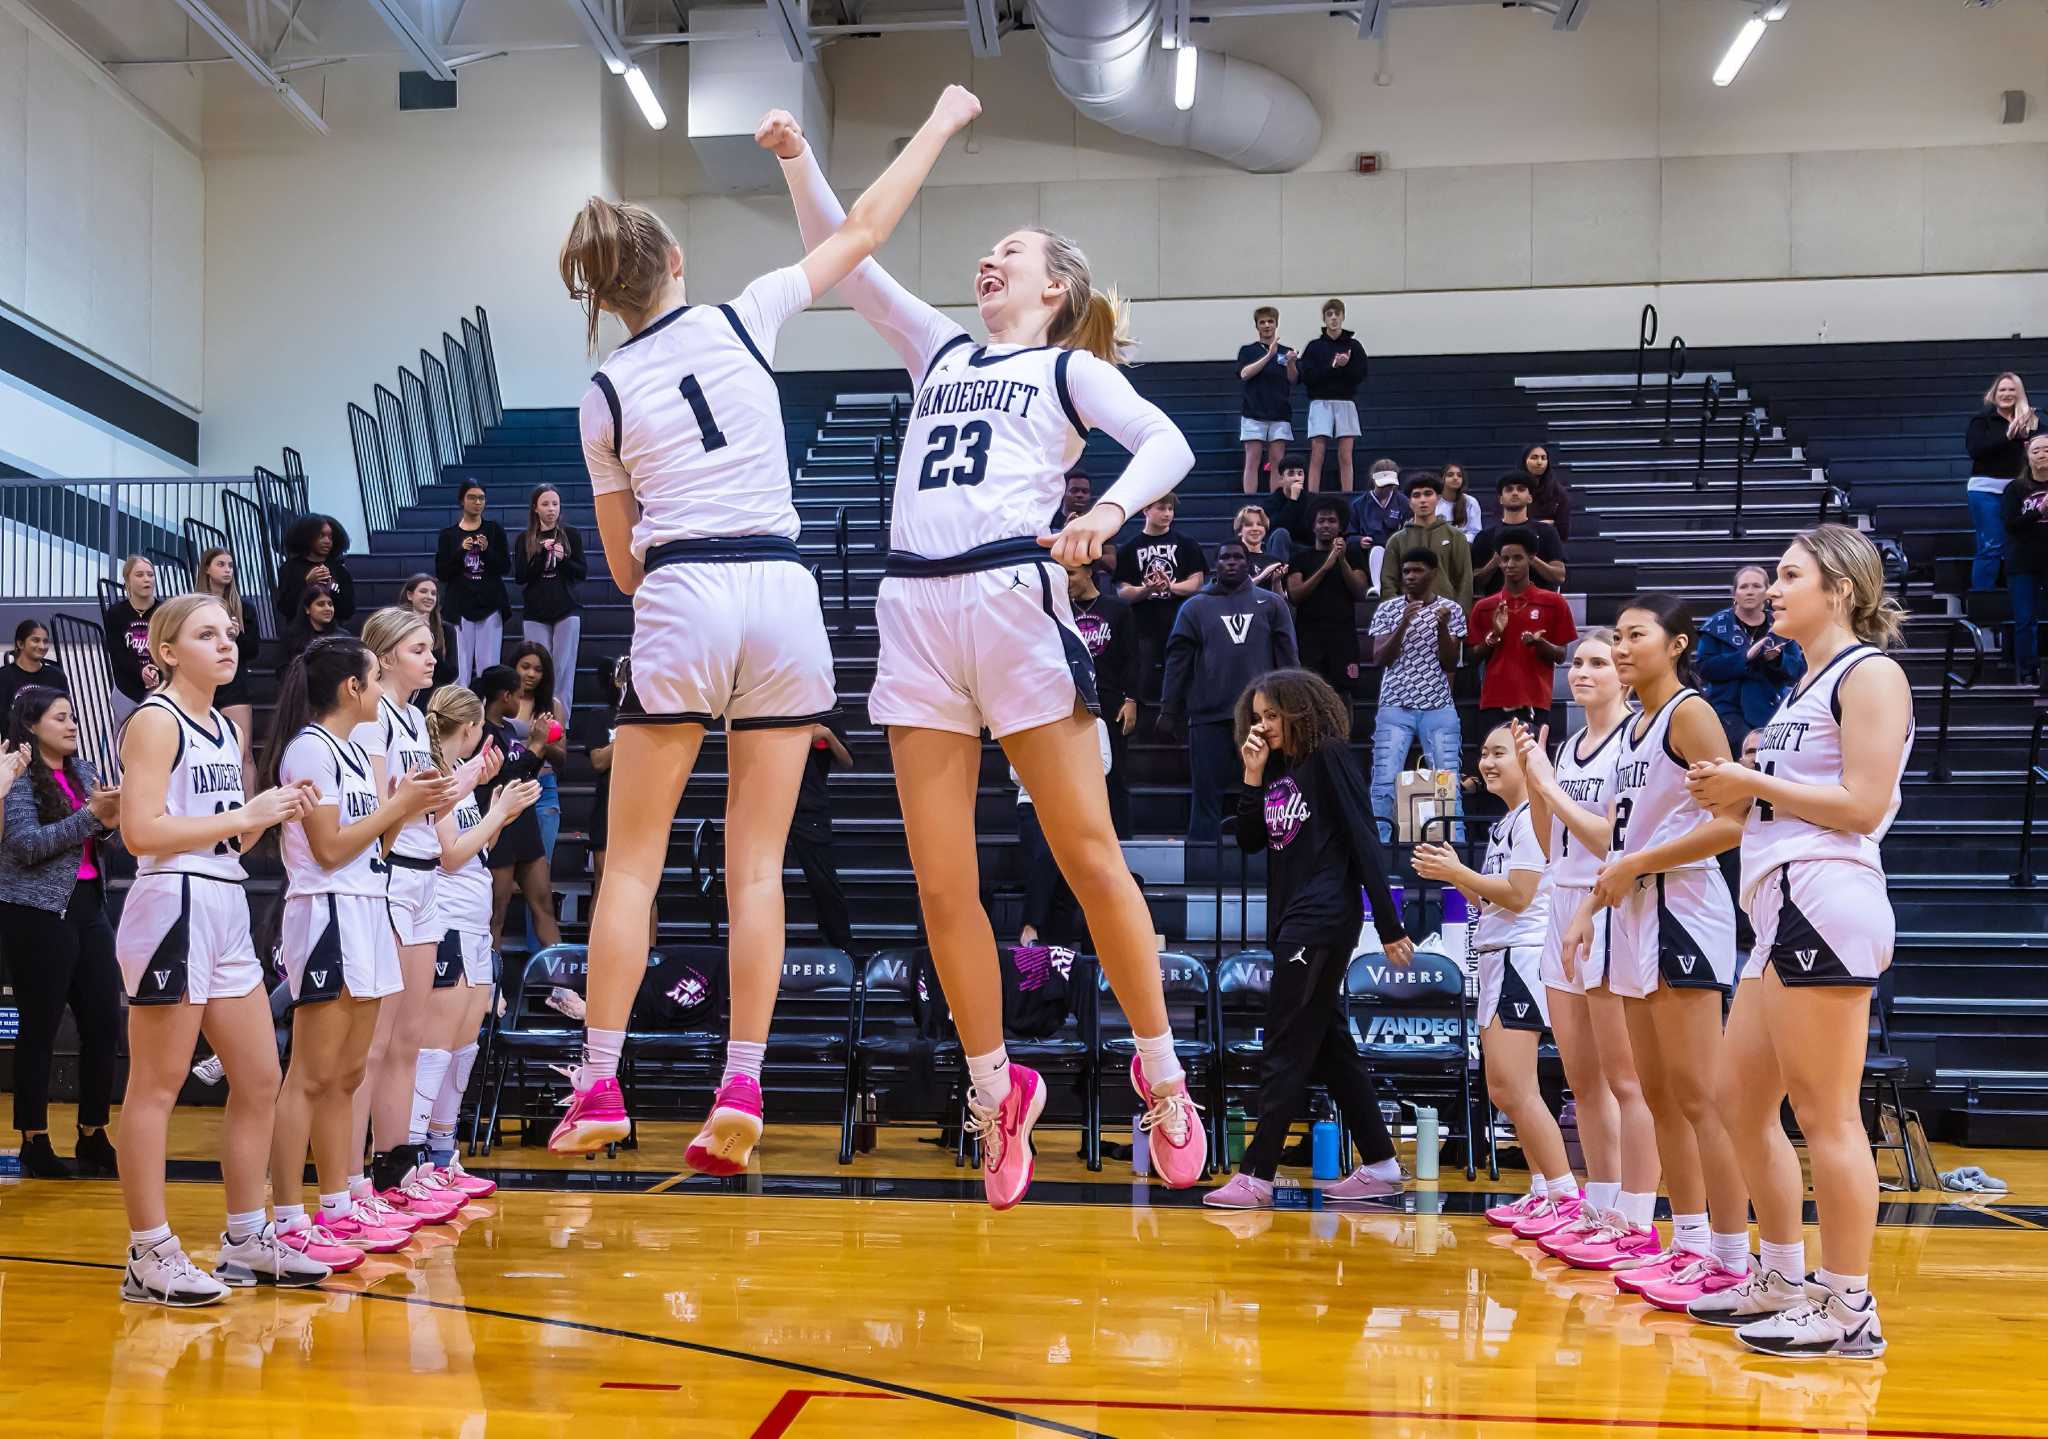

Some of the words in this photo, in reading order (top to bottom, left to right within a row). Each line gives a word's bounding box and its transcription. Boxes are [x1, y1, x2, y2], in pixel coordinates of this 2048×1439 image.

[917, 380, 1039, 420] VANDEGRIFT
[678, 374, 728, 453] 1
[918, 420, 992, 491] 23
[1137, 544, 1178, 571] PACK
[1610, 797, 1633, 851] 2
[544, 956, 588, 977] VIPE
[783, 963, 837, 976] IPERS
[1160, 967, 1193, 982] ERS
[1235, 962, 1274, 985] VIP
[1366, 965, 1444, 986] VIPERS
